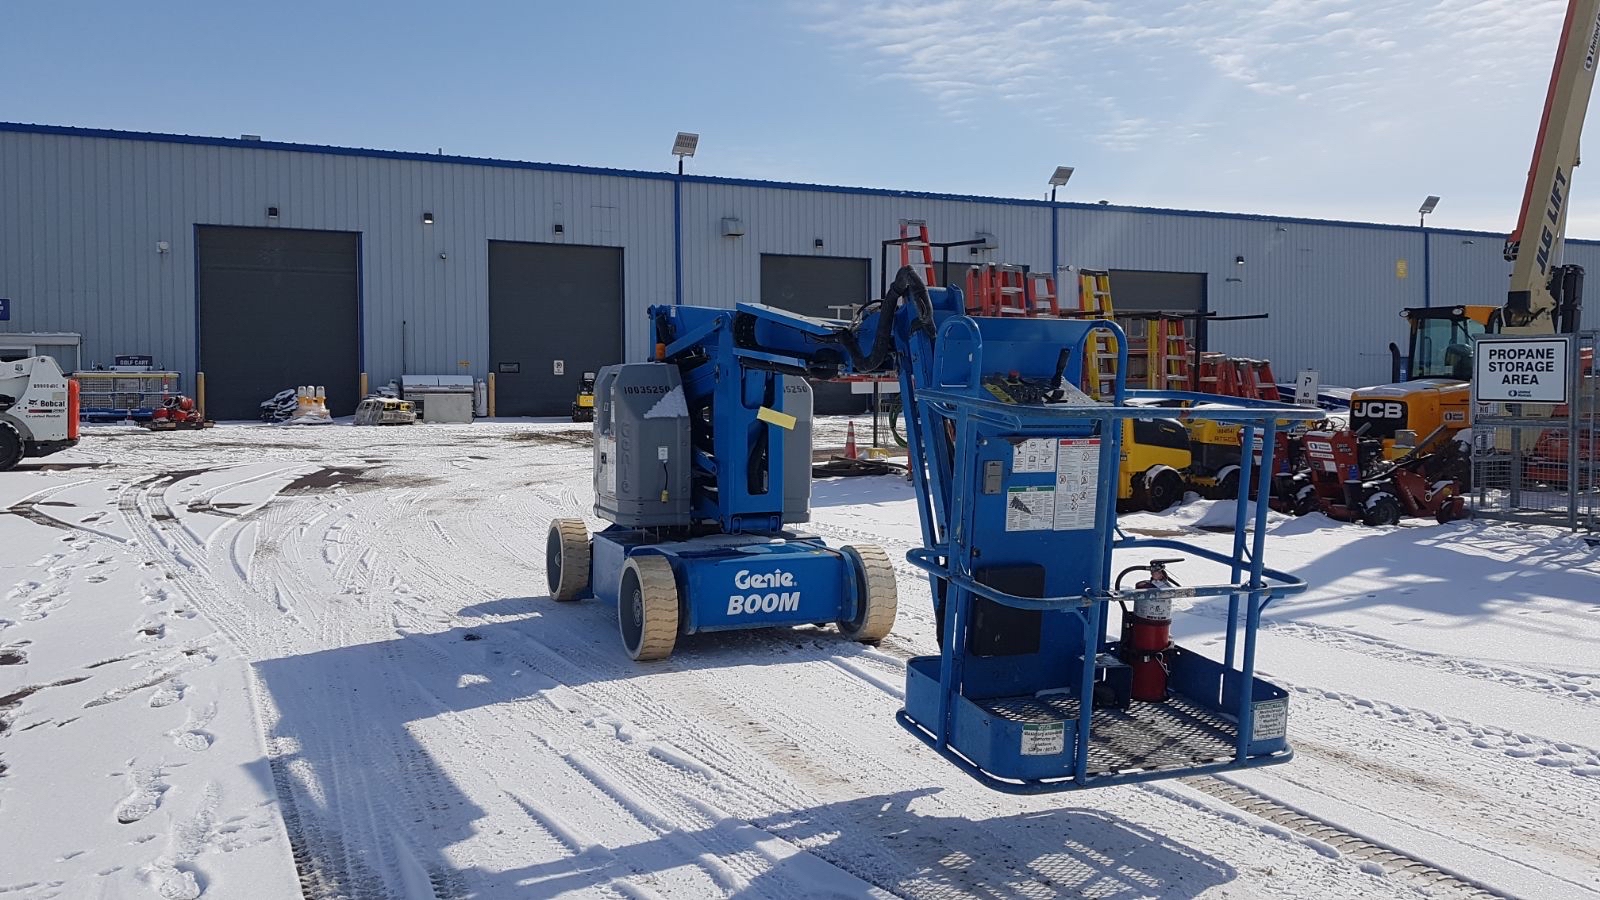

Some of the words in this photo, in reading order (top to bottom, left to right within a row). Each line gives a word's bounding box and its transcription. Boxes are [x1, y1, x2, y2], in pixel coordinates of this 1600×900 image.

[1536, 225, 1553, 276] JLG
[1547, 166, 1566, 226] LIFT
[1489, 348, 1554, 359] PROPANE
[1488, 361, 1554, 372] STORAGE
[1502, 374, 1539, 385] AREA
[624, 385, 671, 395] 10035250
[783, 385, 808, 393] 5250
[1354, 402, 1403, 419] JCB
[735, 568, 794, 590] Genie
[727, 592, 801, 615] BOOM
